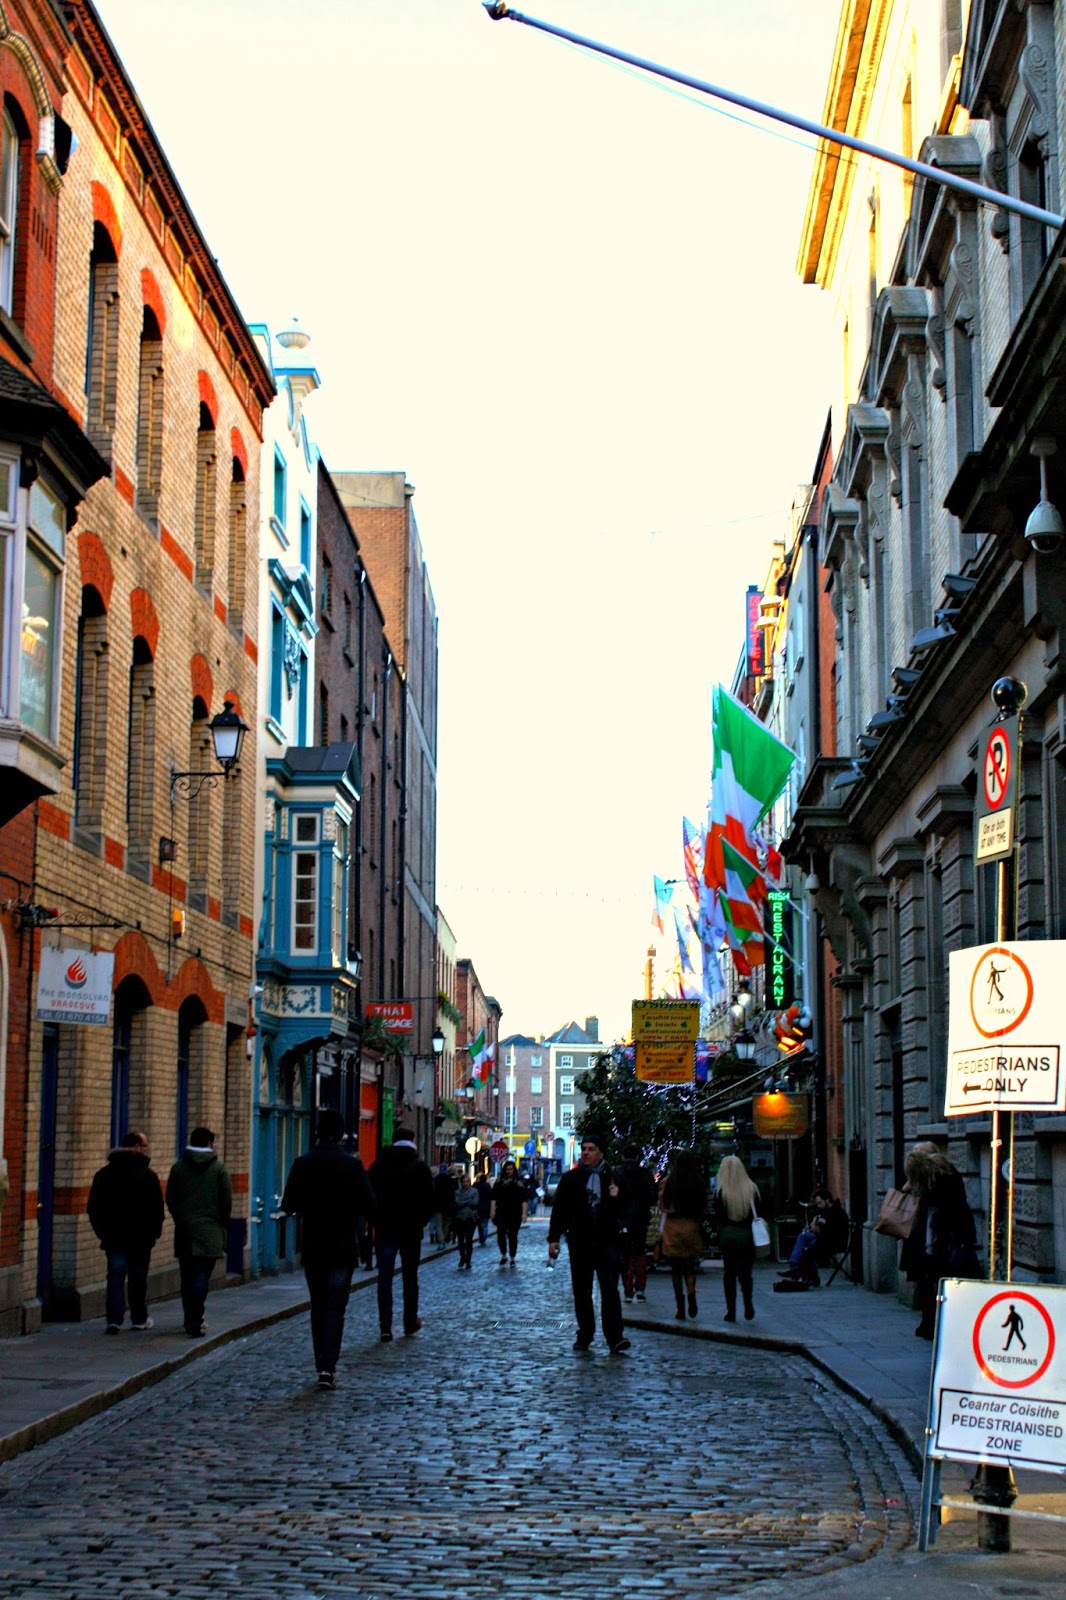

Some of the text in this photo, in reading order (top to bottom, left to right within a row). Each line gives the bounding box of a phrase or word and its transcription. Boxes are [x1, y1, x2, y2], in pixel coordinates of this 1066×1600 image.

[772, 901, 784, 1007] RESTAURANT
[67, 1012, 84, 1022] 670
[374, 1006, 405, 1016] THAI
[957, 1057, 1051, 1075] PEDESTRIANS
[985, 1078, 1028, 1093] ONLY
[489, 1147, 509, 1156] STOP
[987, 1354, 1038, 1366] PEDESTRIANS
[958, 1396, 1060, 1420] Ceantar Coisithe
[951, 1413, 1063, 1439] PEDESTRIANISED
[985, 1435, 1023, 1452] ZONE
